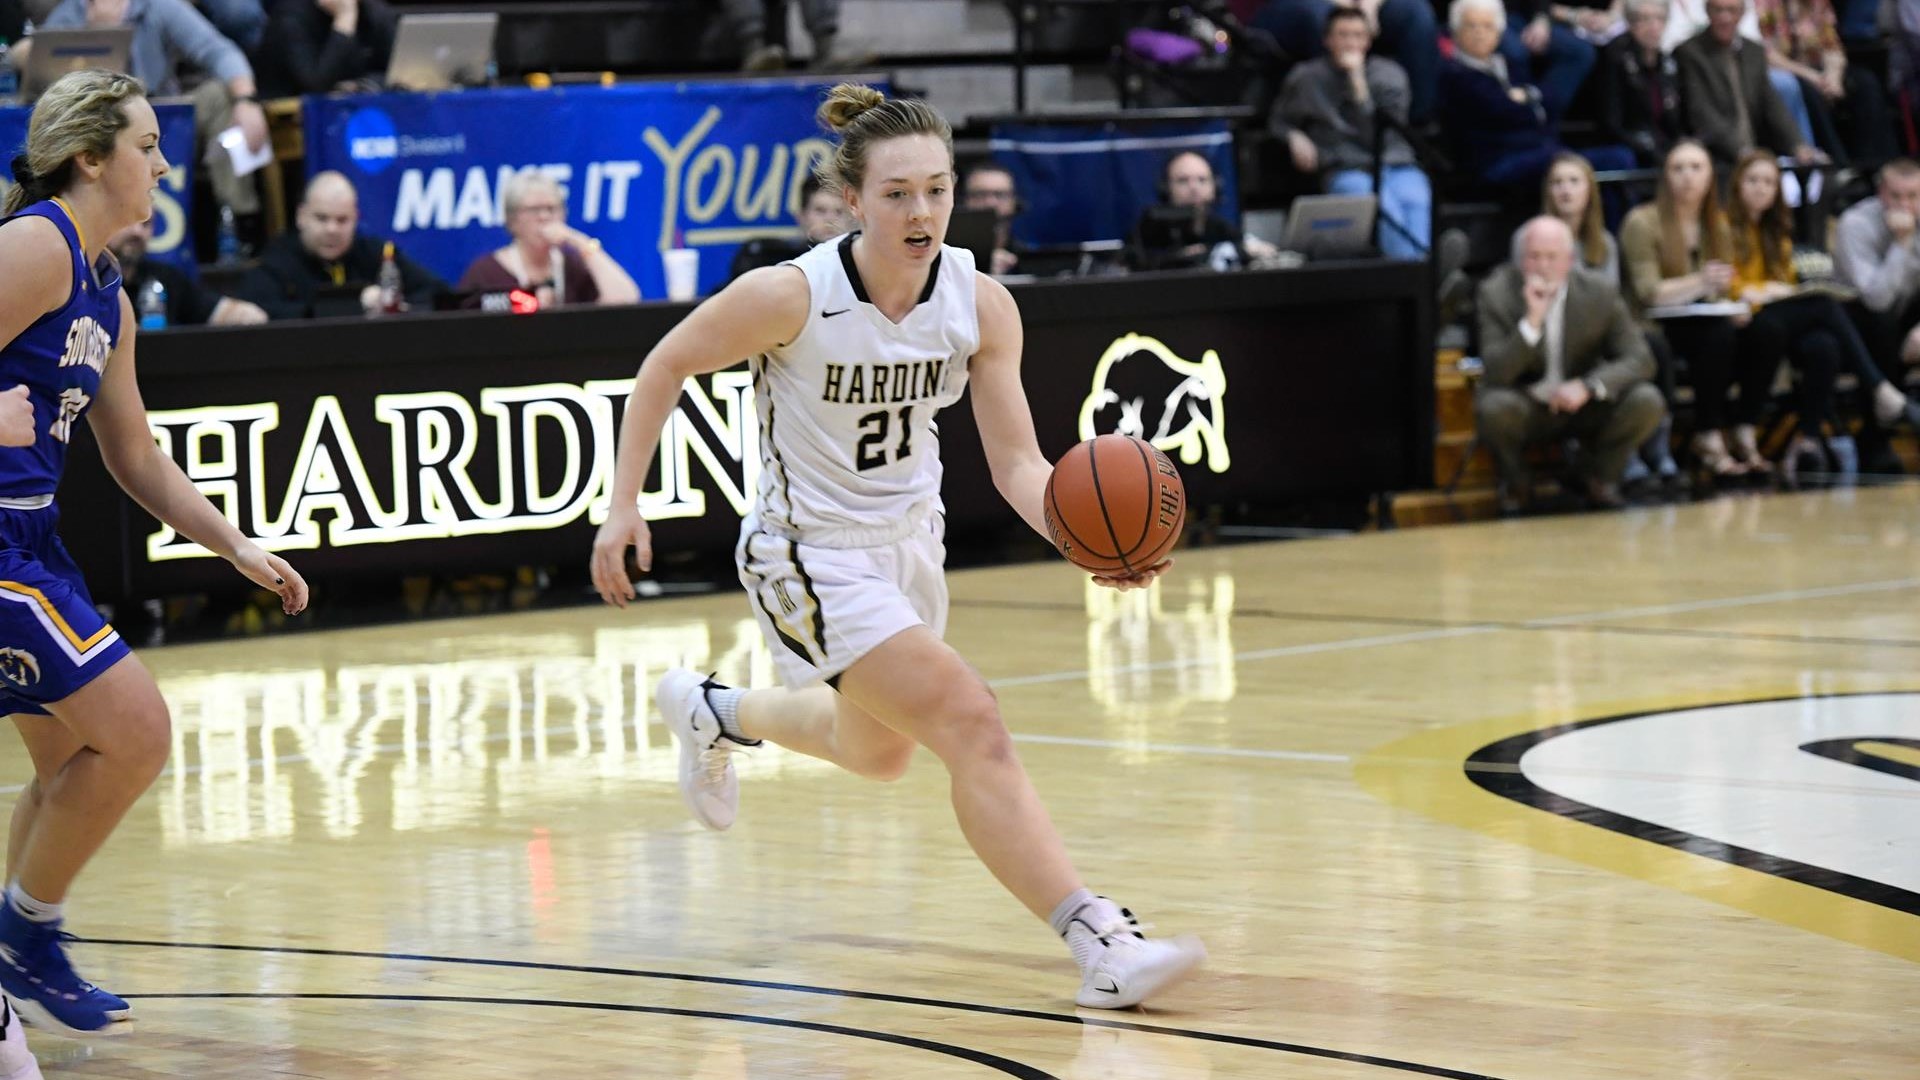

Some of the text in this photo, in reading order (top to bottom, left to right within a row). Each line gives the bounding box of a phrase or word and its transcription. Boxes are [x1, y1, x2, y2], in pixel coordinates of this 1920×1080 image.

[582, 160, 643, 223] IT
[822, 359, 949, 404] HARDIN
[855, 405, 915, 472] 21
[1157, 482, 1180, 529] THE
